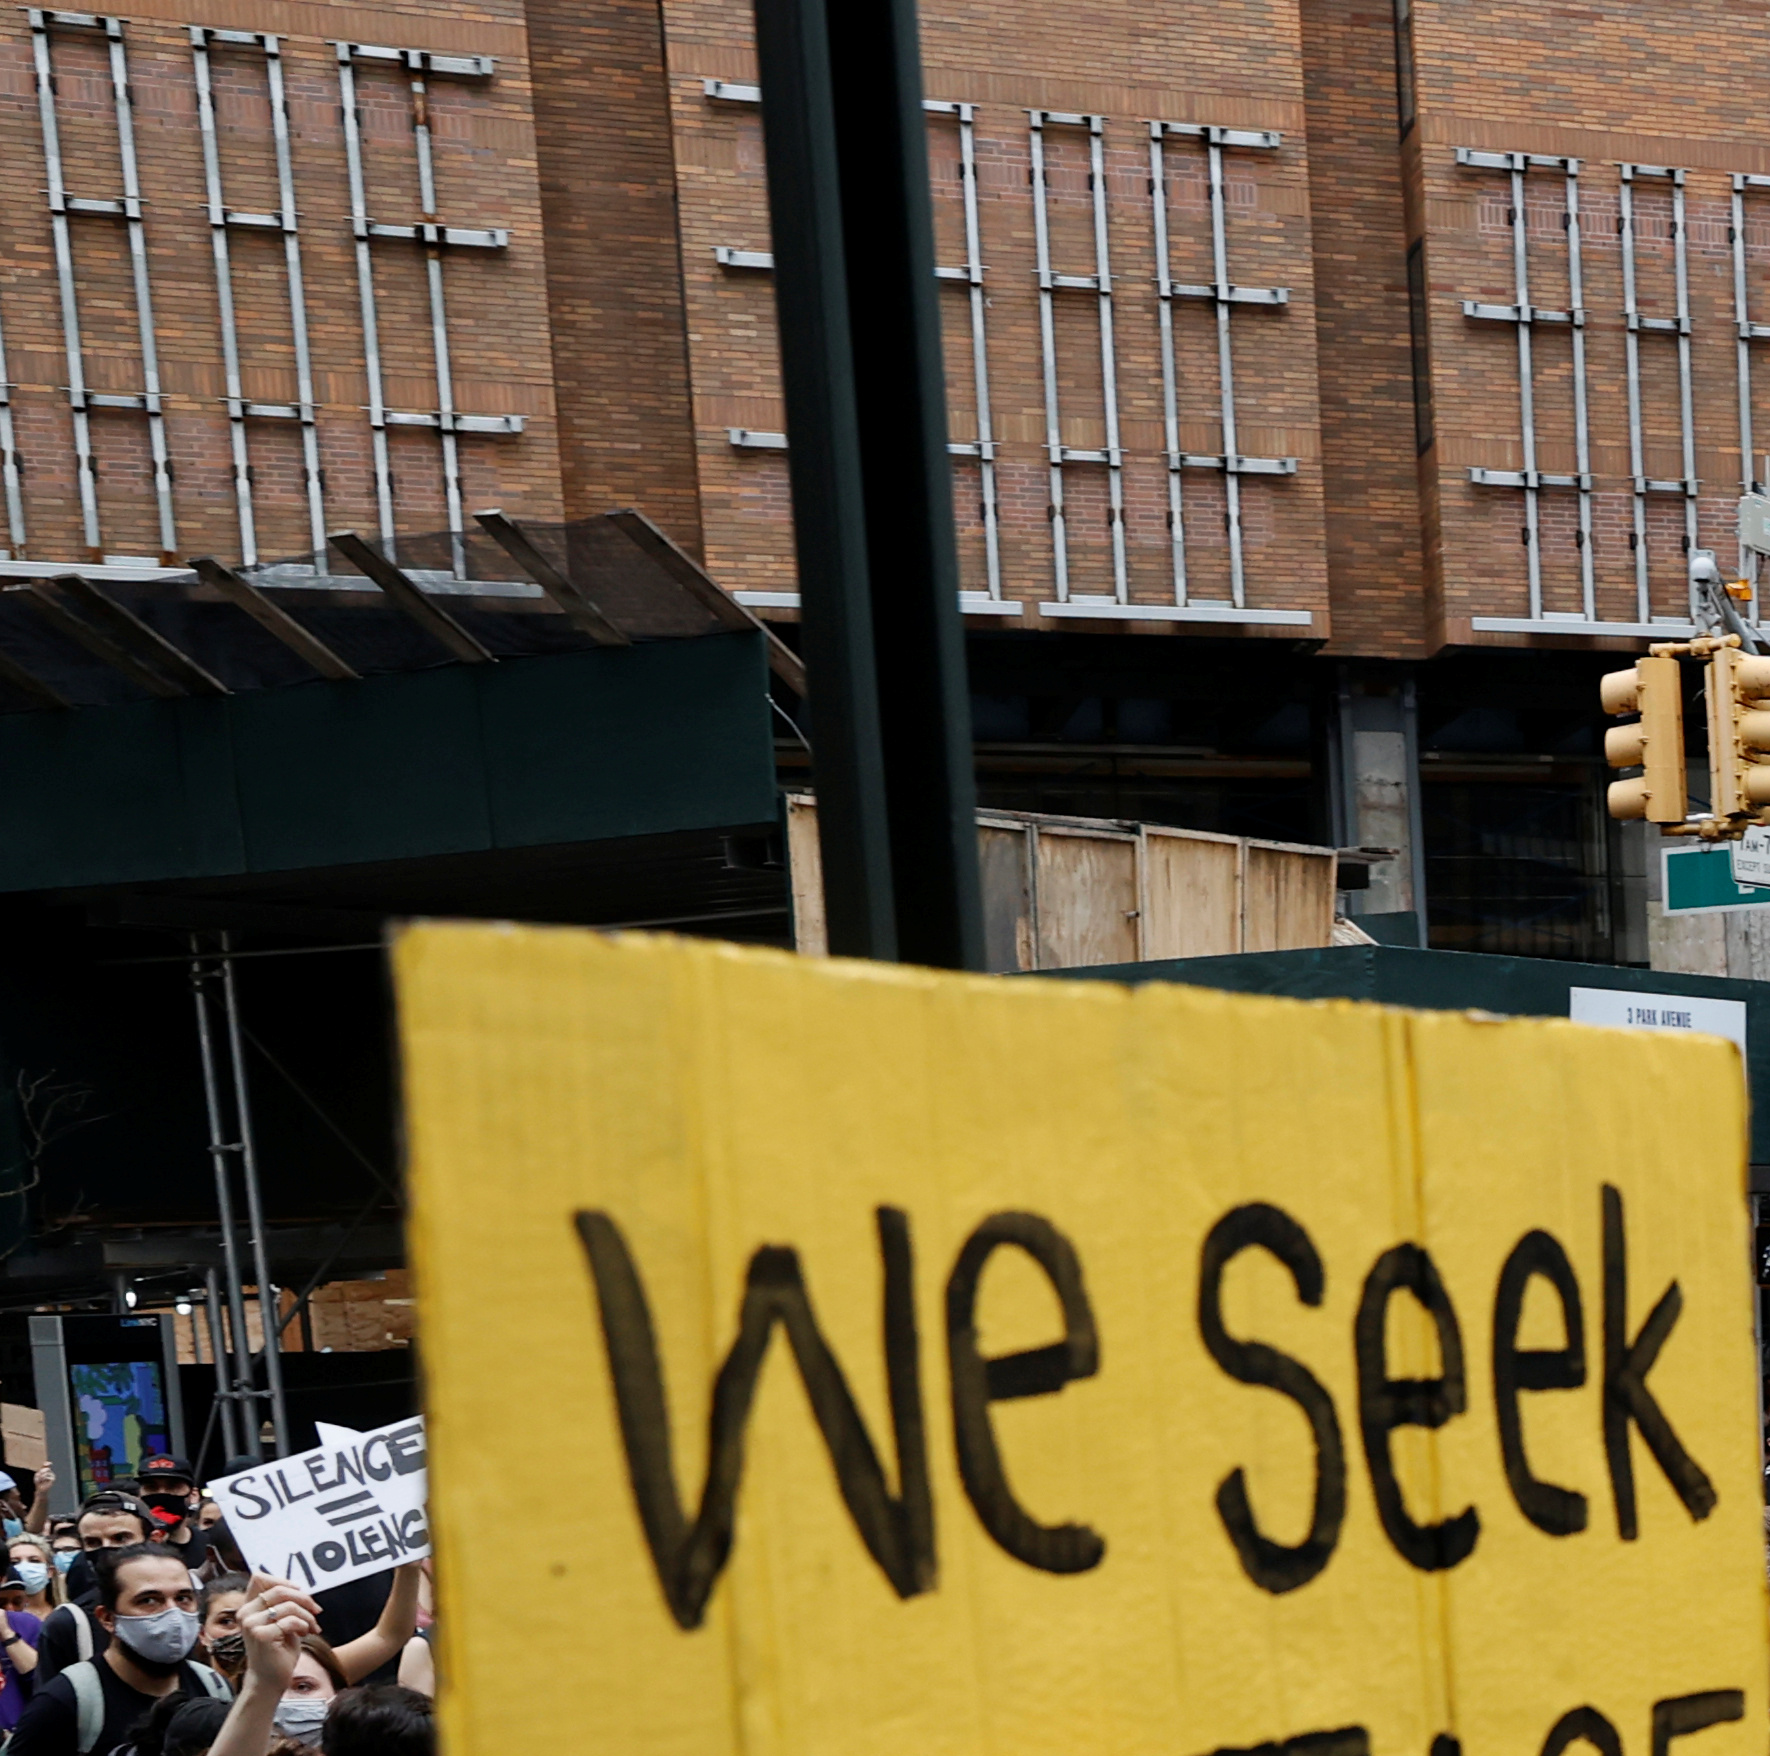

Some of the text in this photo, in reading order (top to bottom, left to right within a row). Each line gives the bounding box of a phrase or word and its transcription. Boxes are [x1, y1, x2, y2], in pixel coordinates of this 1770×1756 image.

[1626, 1006, 1692, 1029] 3 PARK AVENUE
[228, 1423, 428, 1520] SILENCE
[259, 1508, 430, 1588] VIOLENC
